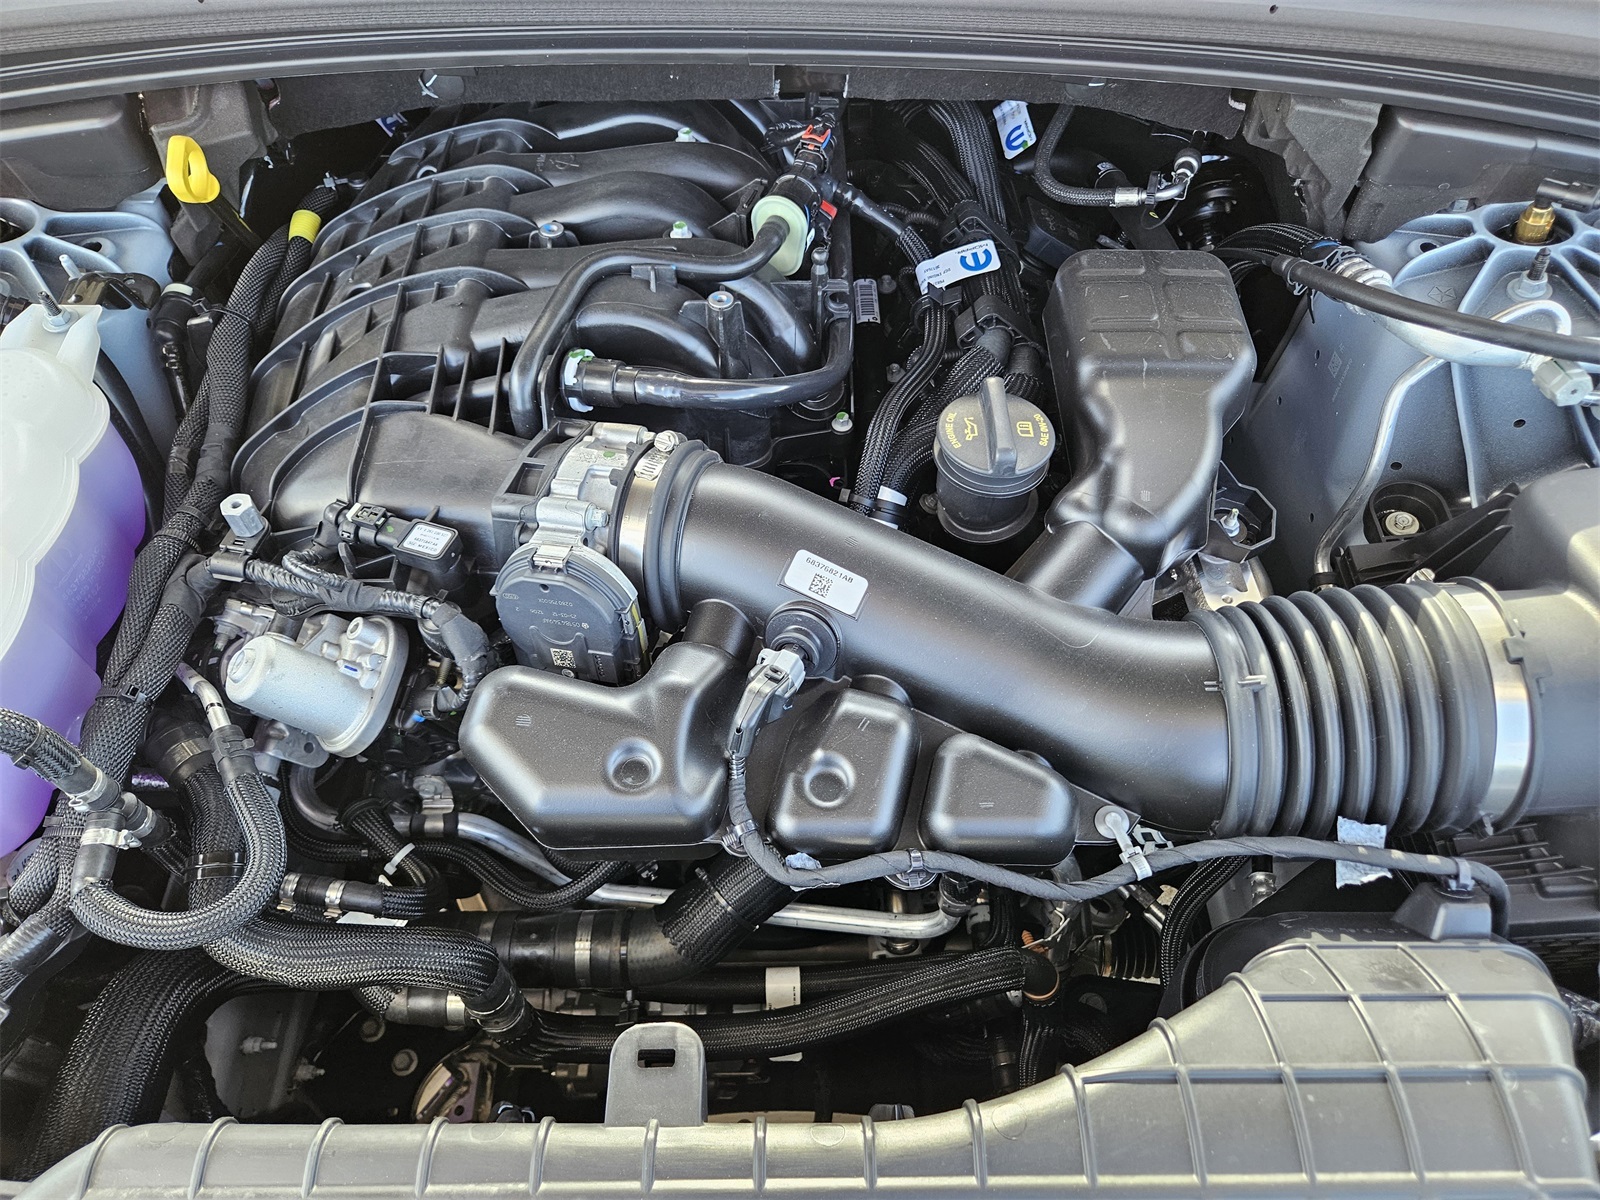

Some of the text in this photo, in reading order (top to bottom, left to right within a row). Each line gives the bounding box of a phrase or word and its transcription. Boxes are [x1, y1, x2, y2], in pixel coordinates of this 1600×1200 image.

[945, 412, 962, 449] ENGINE OIL
[1033, 413, 1049, 447] SAE 0W-20
[805, 557, 854, 583] 68376821AB
